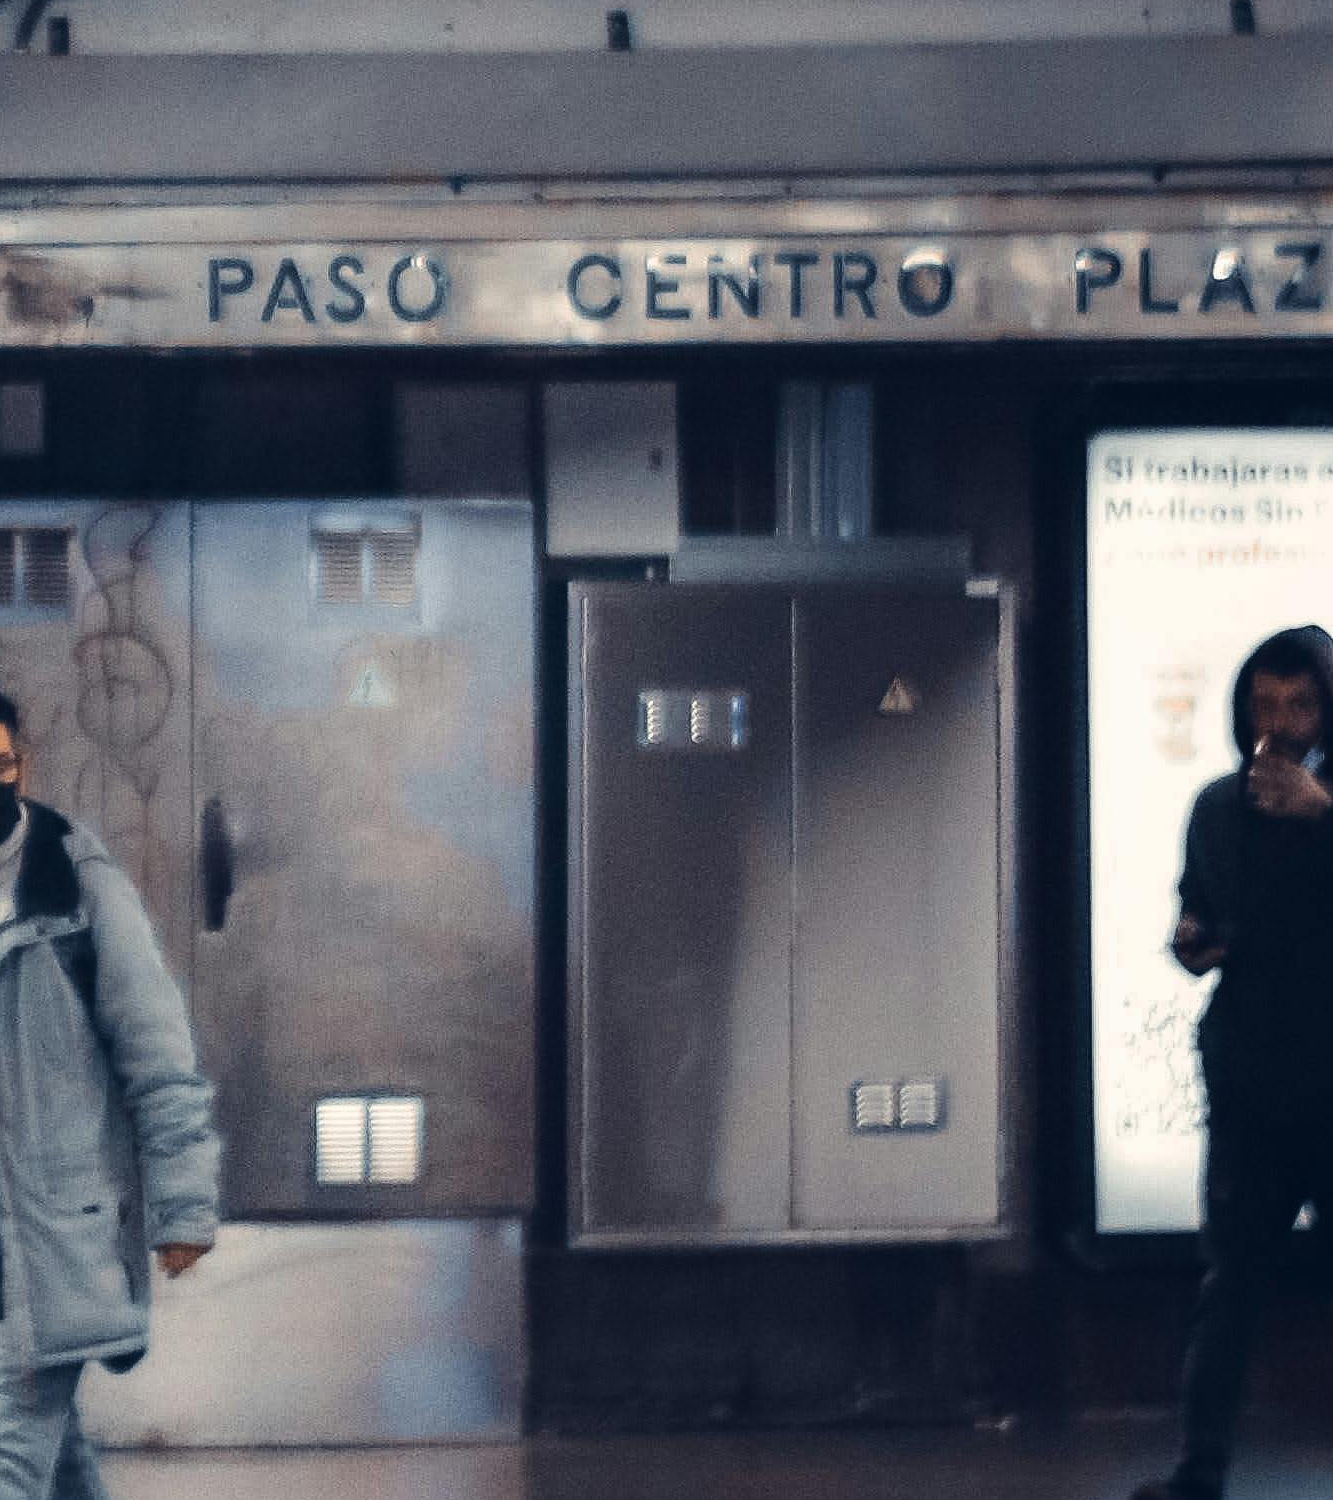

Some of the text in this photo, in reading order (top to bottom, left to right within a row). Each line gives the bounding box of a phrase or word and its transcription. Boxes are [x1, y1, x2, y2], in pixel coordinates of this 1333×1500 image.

[206, 239, 1322, 324] PASO CENTRO PLAZ
